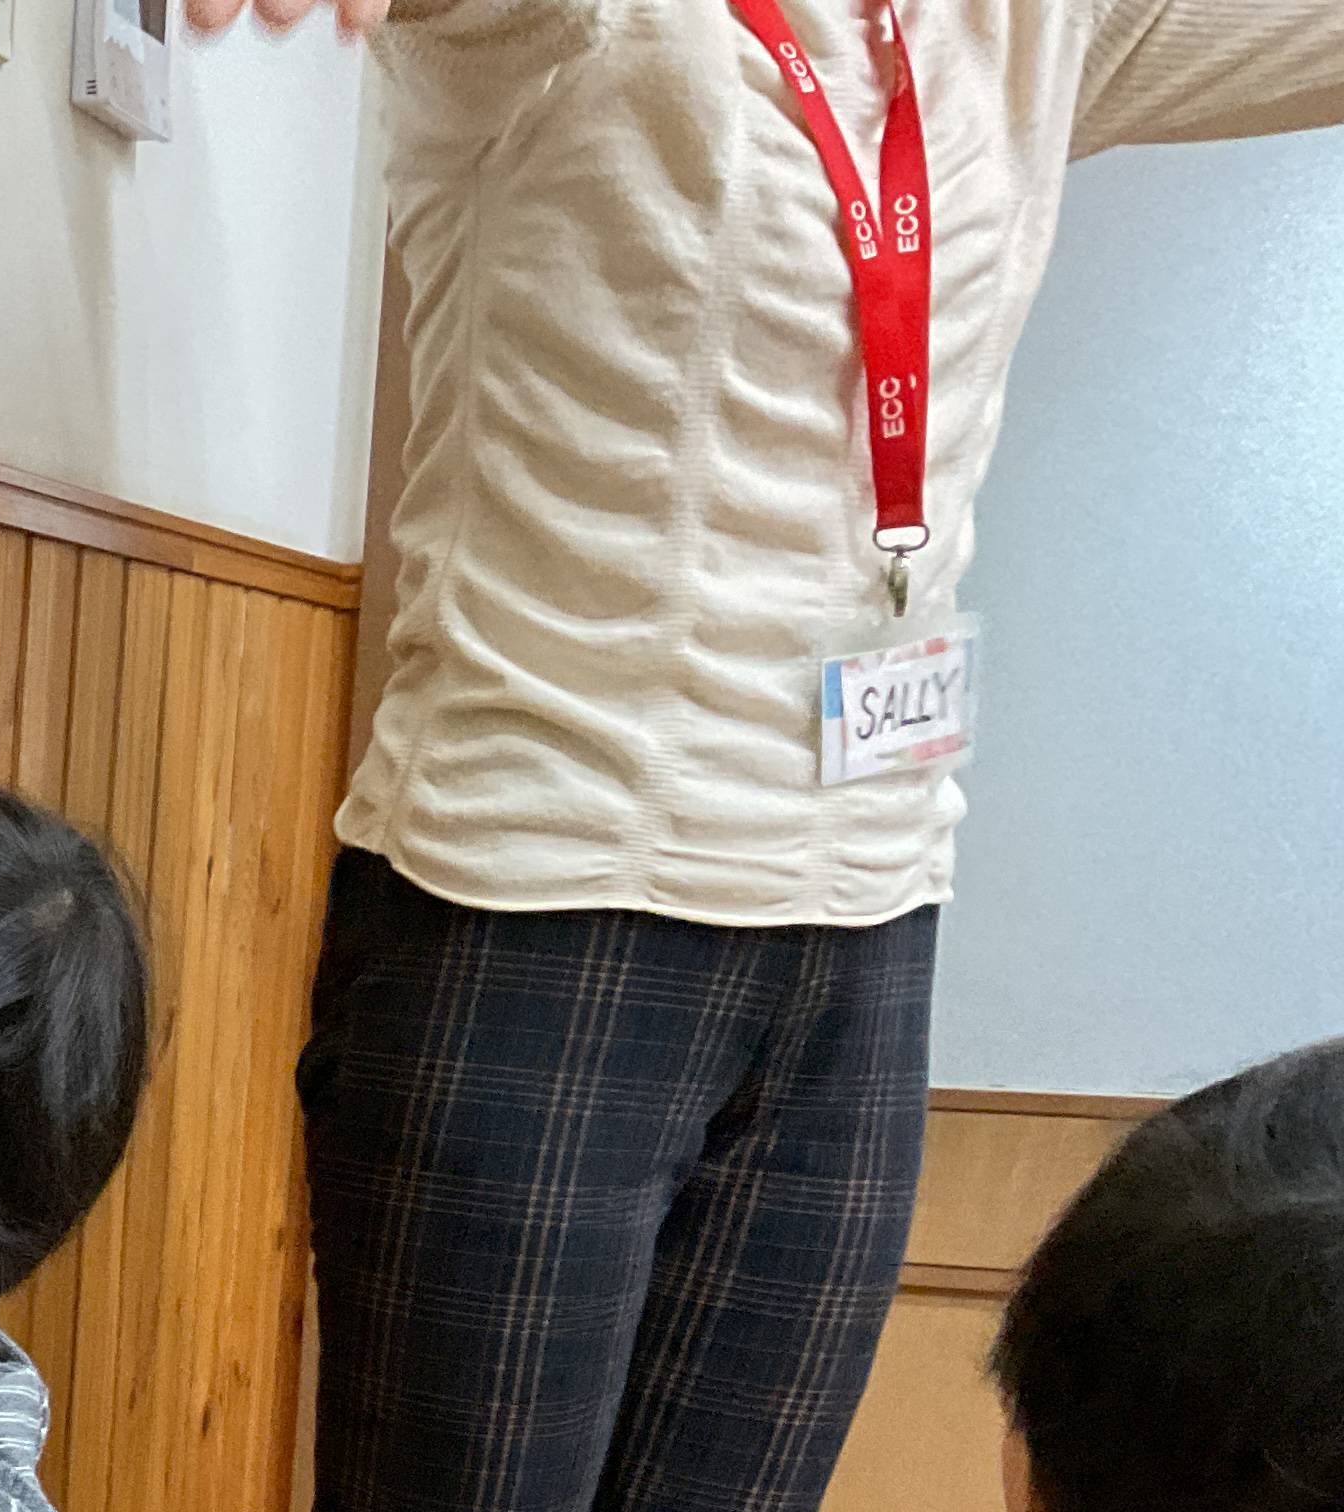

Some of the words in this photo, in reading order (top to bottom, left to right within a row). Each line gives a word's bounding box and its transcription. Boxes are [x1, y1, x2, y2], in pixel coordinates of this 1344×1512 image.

[850, 200, 878, 260] ECC
[894, 192, 920, 254] ECC
[879, 376, 905, 438] ECC
[855, 667, 962, 740] SALLY
